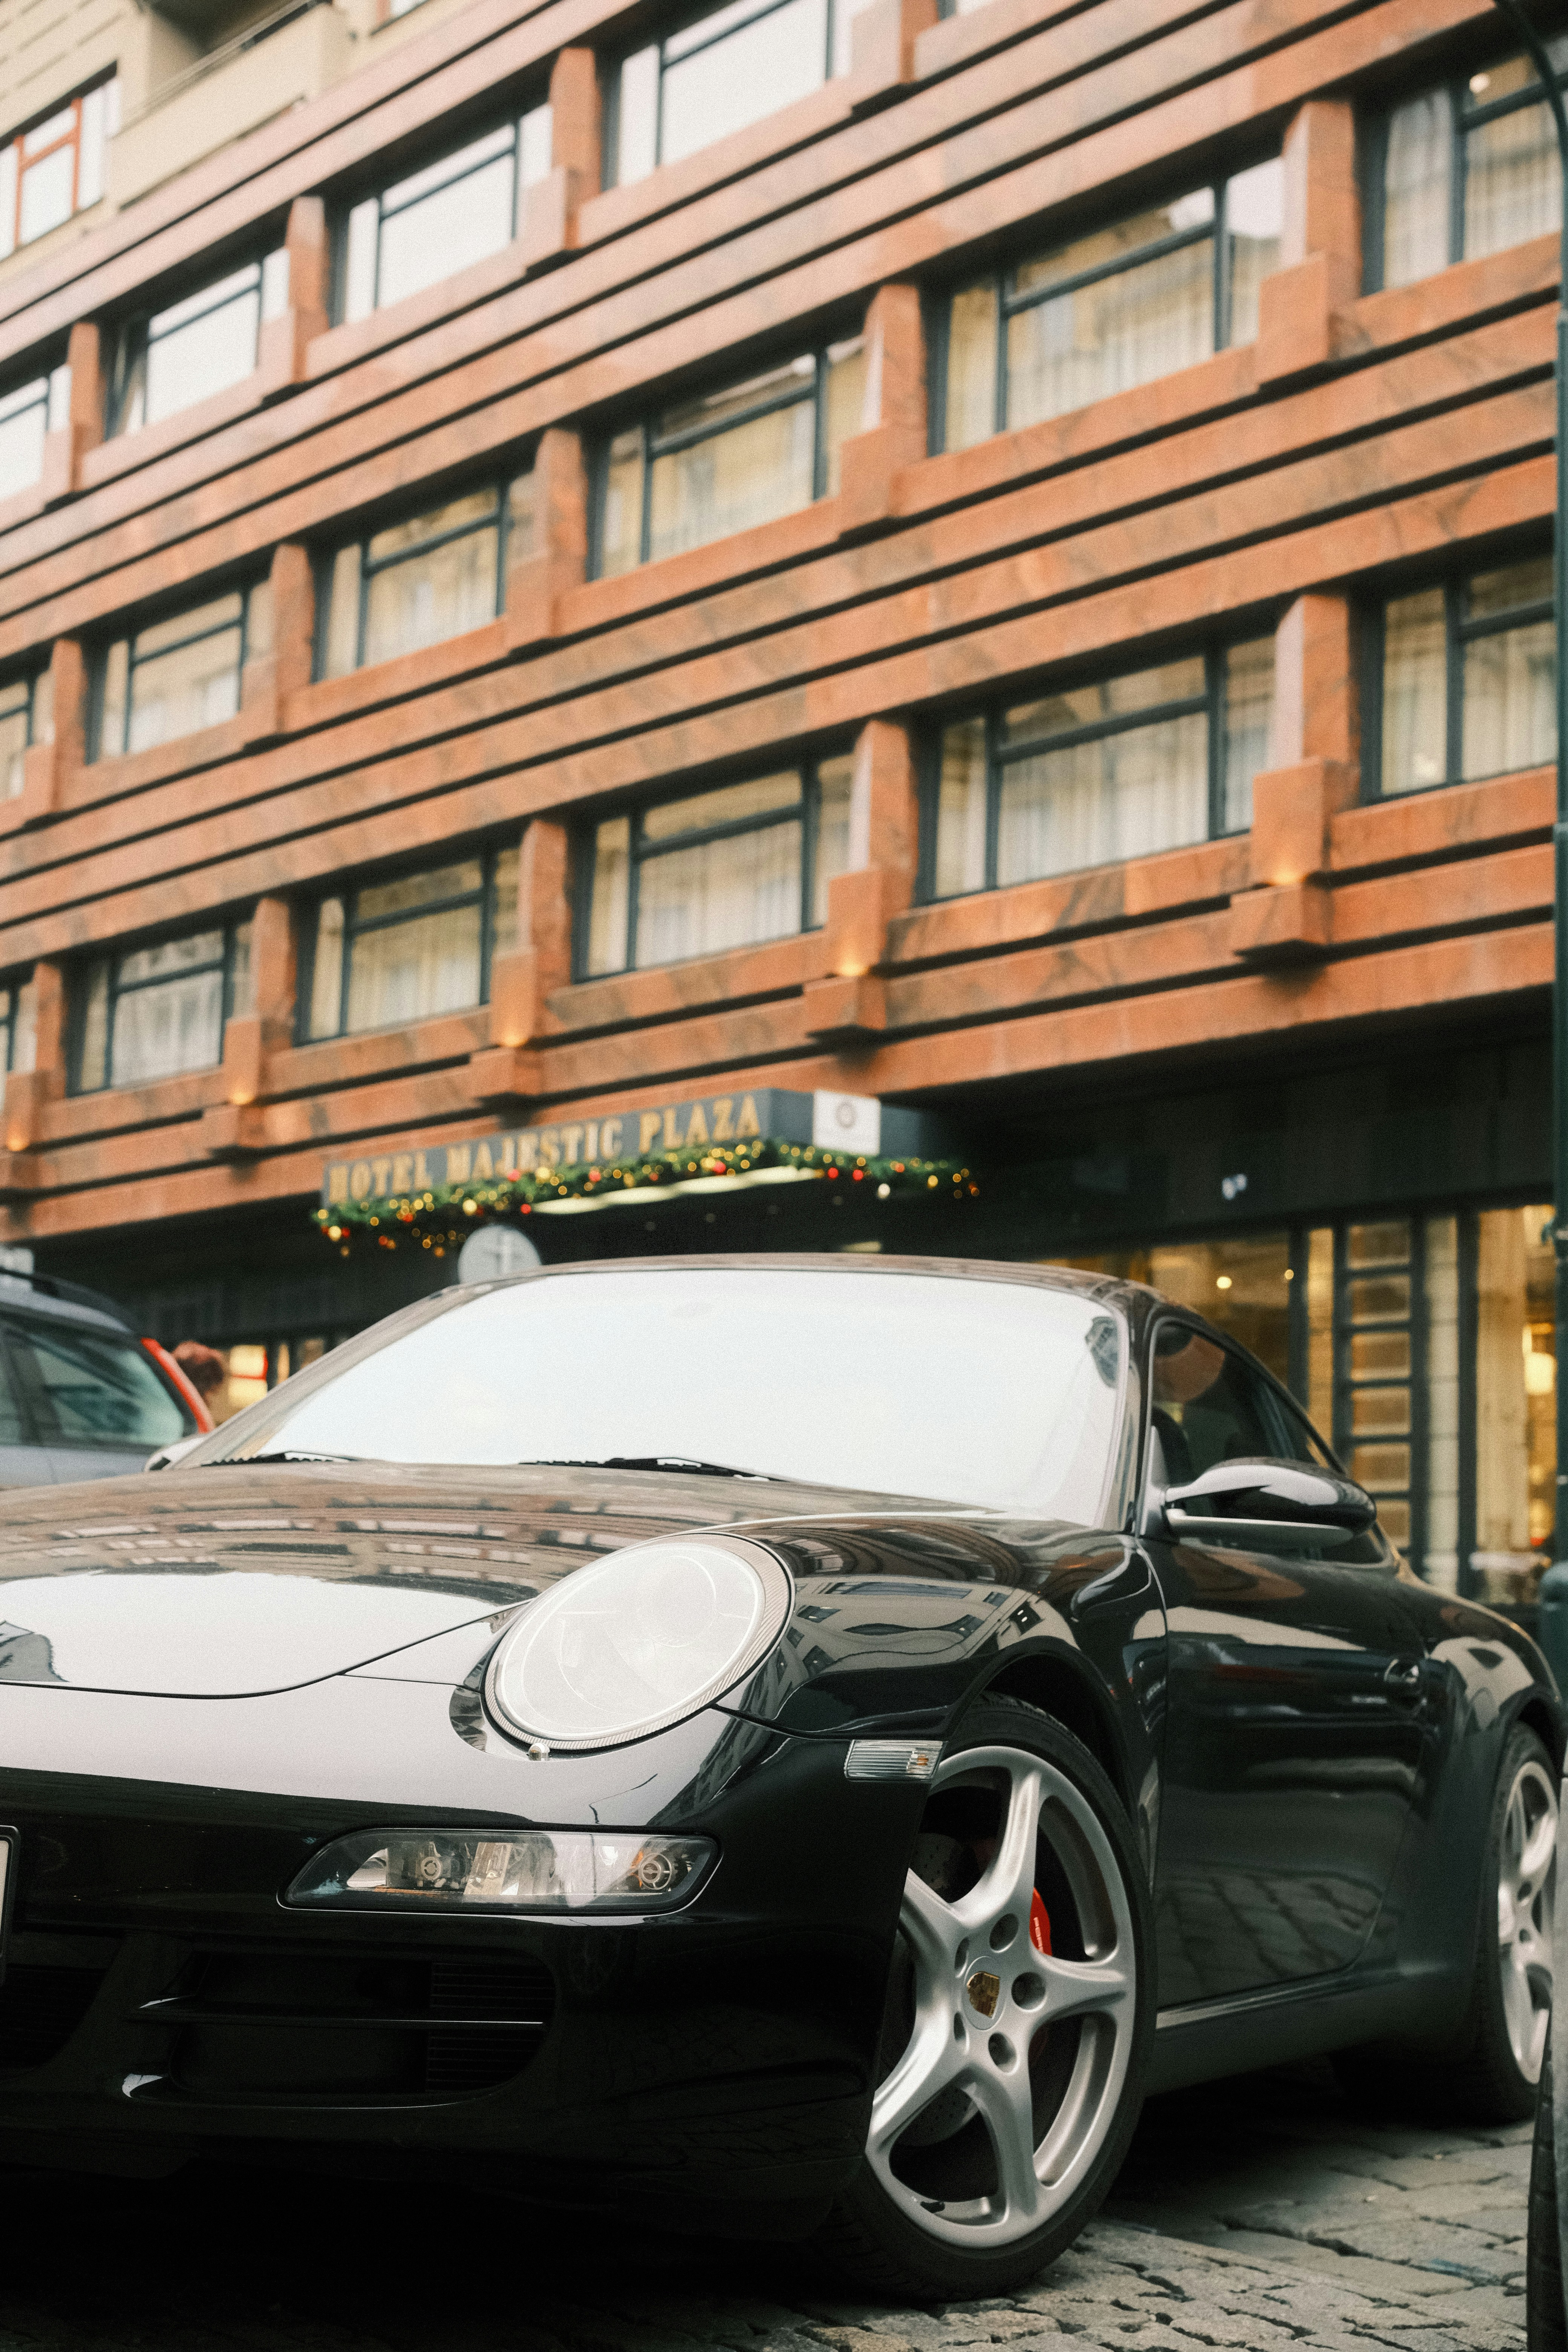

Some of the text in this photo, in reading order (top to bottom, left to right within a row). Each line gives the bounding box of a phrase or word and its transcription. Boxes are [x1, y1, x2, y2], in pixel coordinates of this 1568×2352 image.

[328, 1094, 761, 1204] HOTEL MAJESTIC PLAZA
